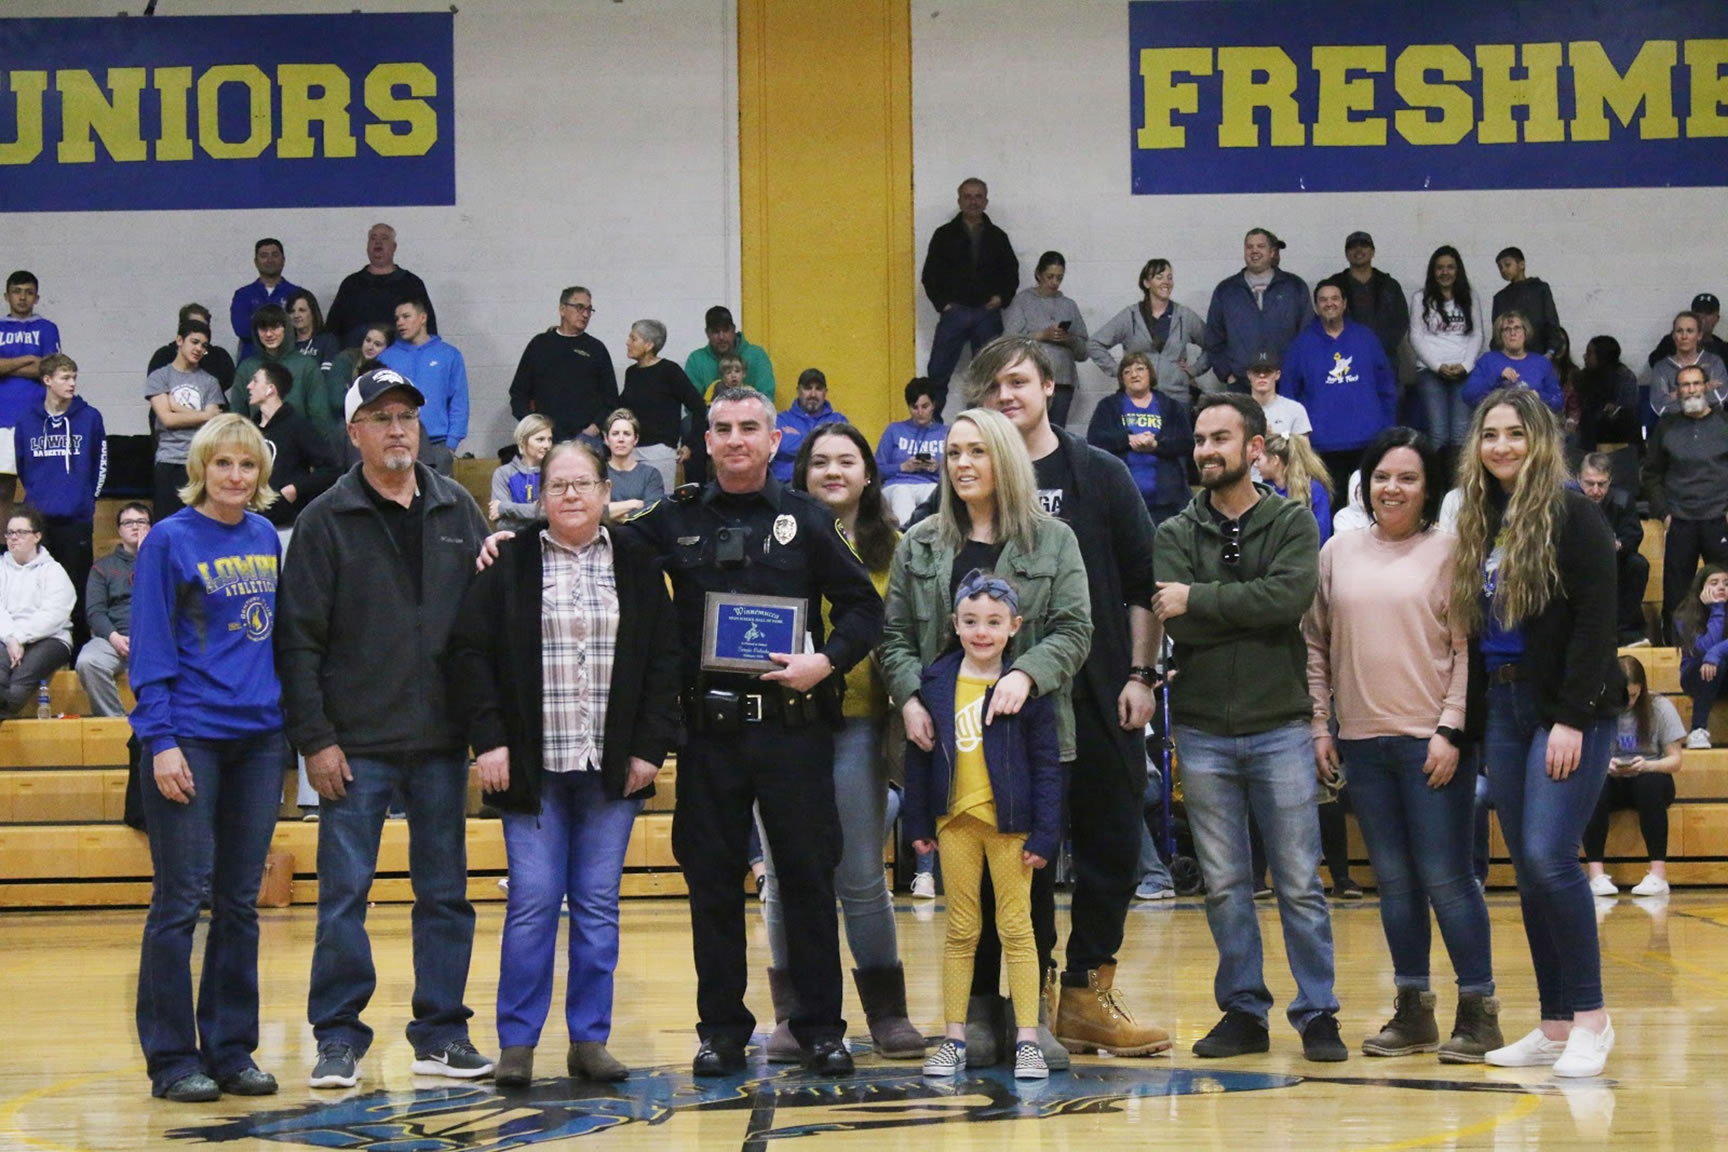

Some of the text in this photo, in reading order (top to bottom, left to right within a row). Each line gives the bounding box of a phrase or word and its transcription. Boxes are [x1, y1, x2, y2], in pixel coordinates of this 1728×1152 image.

[0, 62, 438, 165] UNIORS
[1136, 39, 1728, 149] FRESHME
[0, 330, 40, 346] LOWRY
